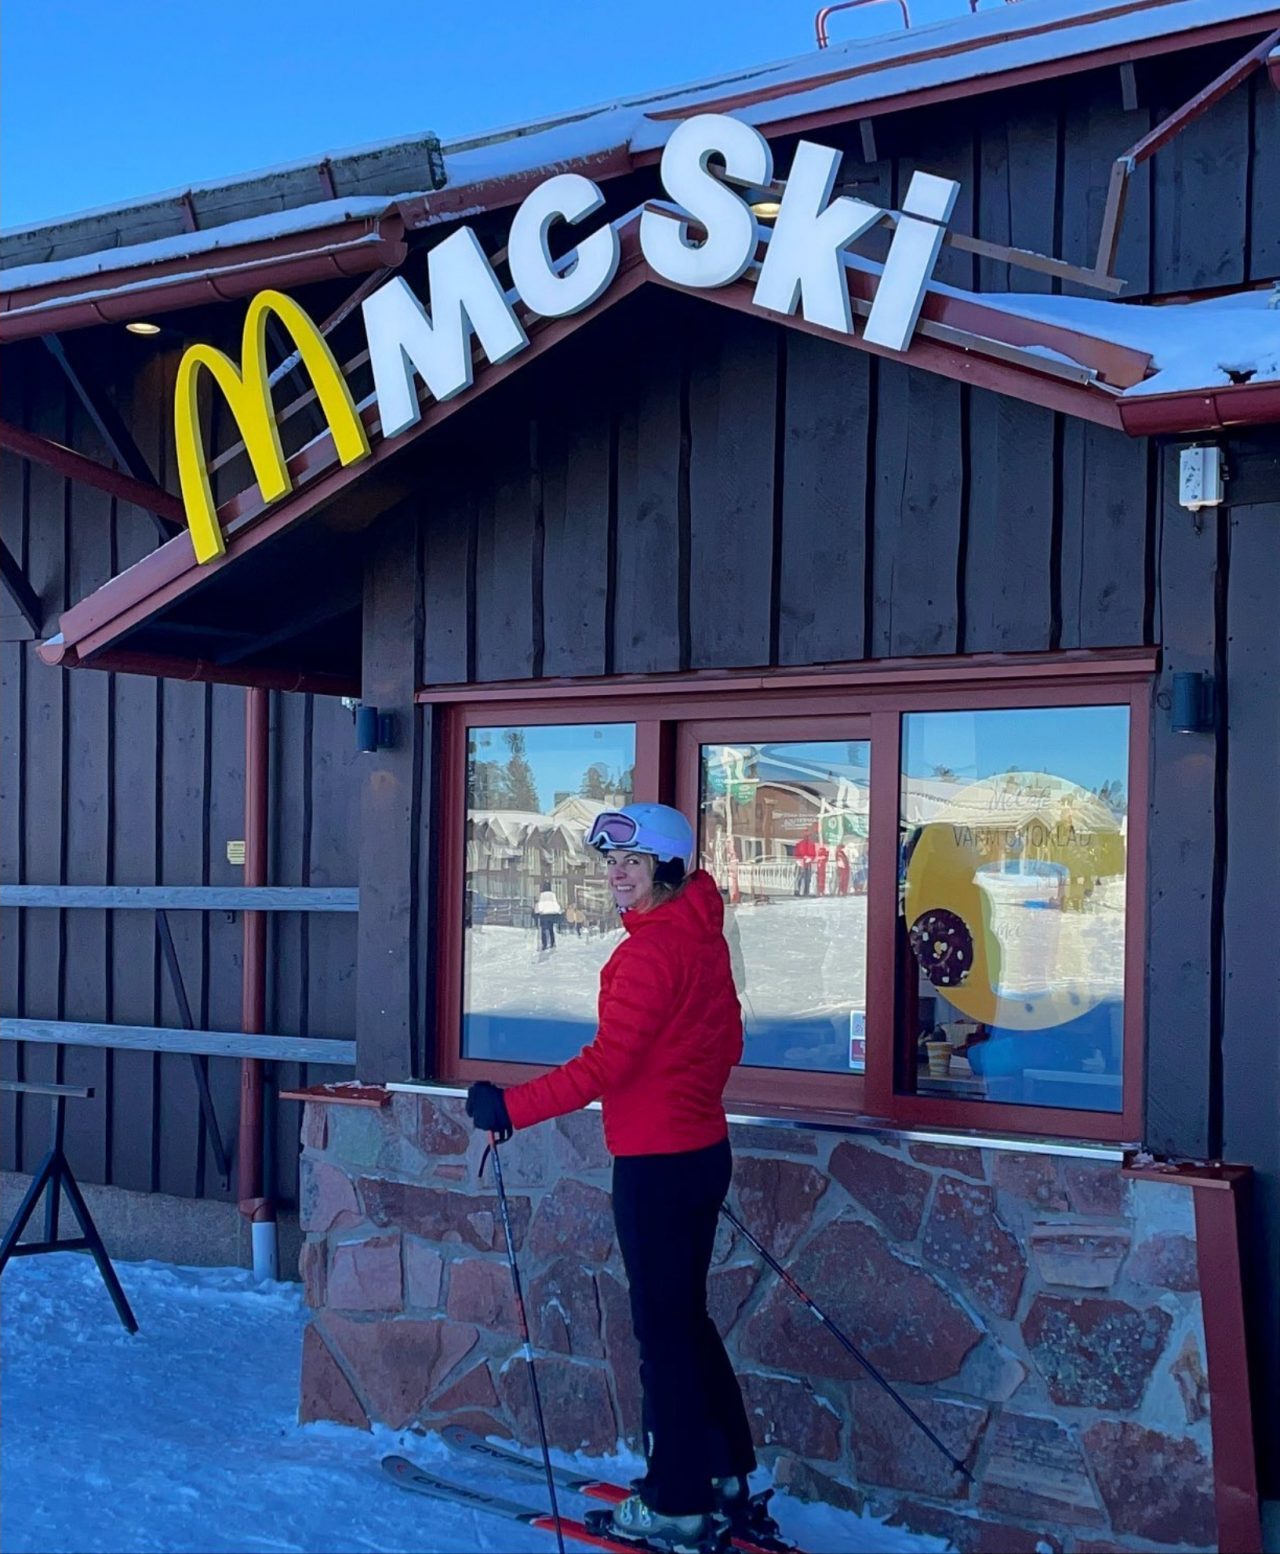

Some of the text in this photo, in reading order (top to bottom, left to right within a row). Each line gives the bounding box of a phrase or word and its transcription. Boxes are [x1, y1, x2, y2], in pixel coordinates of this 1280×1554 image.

[952, 823, 1092, 847] VARM CHOKLAD
[469, 1444, 545, 1471] HEAD
[412, 1475, 494, 1502] HEAD
